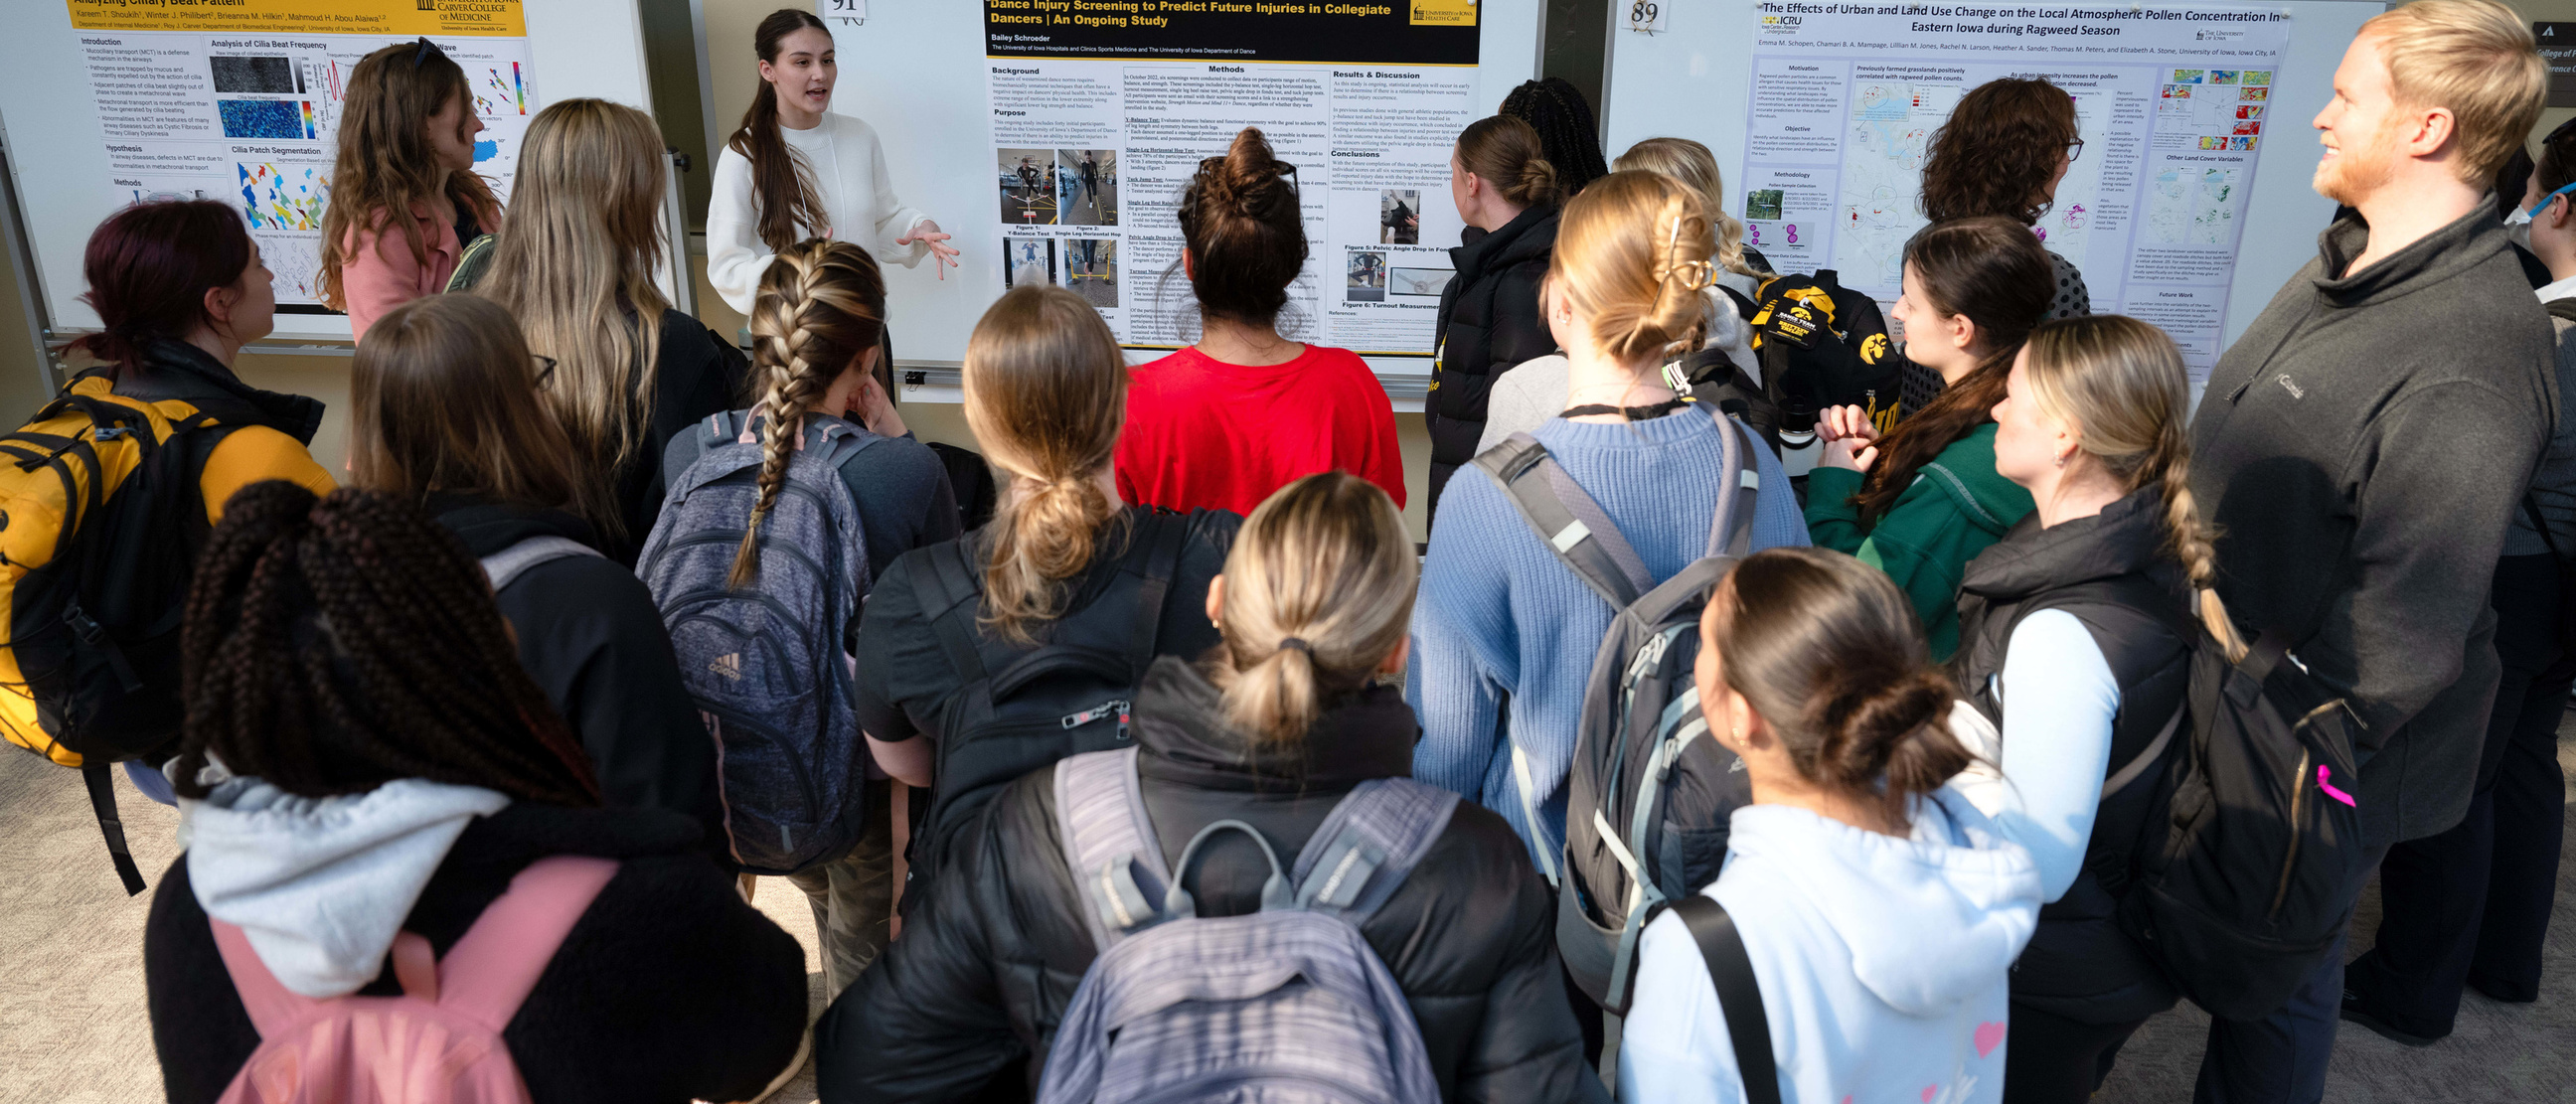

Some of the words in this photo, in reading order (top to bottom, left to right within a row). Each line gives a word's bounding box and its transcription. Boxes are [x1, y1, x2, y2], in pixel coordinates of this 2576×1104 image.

[437, 2, 469, 12] CARVER
[468, 2, 507, 12] COLLEGE
[991, 0, 1030, 9] Dance
[1034, 0, 1069, 12] Injury
[1074, 0, 1139, 13] Screening
[1143, 0, 1156, 11] to
[1160, 0, 1207, 11] Predict
[1210, 1, 1252, 12] Future
[1256, 2, 1305, 15] Injuries
[1309, 2, 1321, 13] in
[1325, 3, 1391, 17] Collegiate
[450, 12, 492, 21] MEDICINE
[1632, 2, 1658, 23] 89
[1763, 3, 1784, 13] The
[1787, 3, 1823, 13] Effects
[1826, 4, 1838, 14] of
[1841, 4, 1874, 14] Urban
[1877, 5, 1898, 15] and
[1901, 5, 1928, 15] Land
[1931, 6, 1952, 16] Use
[1955, 6, 1997, 19] Change
[2017, 8, 2035, 17] the
[2039, 8, 2068, 18] Local
[2071, 8, 2143, 22] Atmospheric
[2146, 10, 2181, 20] Pollen
[2185, 11, 2266, 22] Concentration
[2270, 12, 2280, 22] In
[991, 13, 1043, 24] Dancers
[1053, 14, 1070, 24] An
[1074, 14, 1127, 27] Ongoing
[1131, 15, 1169, 28] Study
[1780, 16, 1802, 25] ICRU
[1911, 22, 1953, 33] Eastern
[1957, 23, 1984, 33] Iowa
[1987, 24, 2023, 36] during
[2026, 25, 2078, 37] Ragweed
[2081, 26, 2121, 36] Season
[992, 34, 1013, 43] Bailey
[212, 39, 242, 49] Analysis
[290, 41, 327, 51] Frequency
[437, 43, 457, 52] Wave
[2178, 48, 2211, 57] University
[992, 68, 1040, 77] Background
[1856, 65, 1885, 74] Previously
[1907, 66, 1937, 75] grasslands
[995, 109, 1027, 118] Purpose
[106, 144, 143, 154] Hypothesis
[271, 146, 322, 156] Segmentation
[1774, 170, 1811, 179] Methodology
[709, 663, 741, 681] adidas
